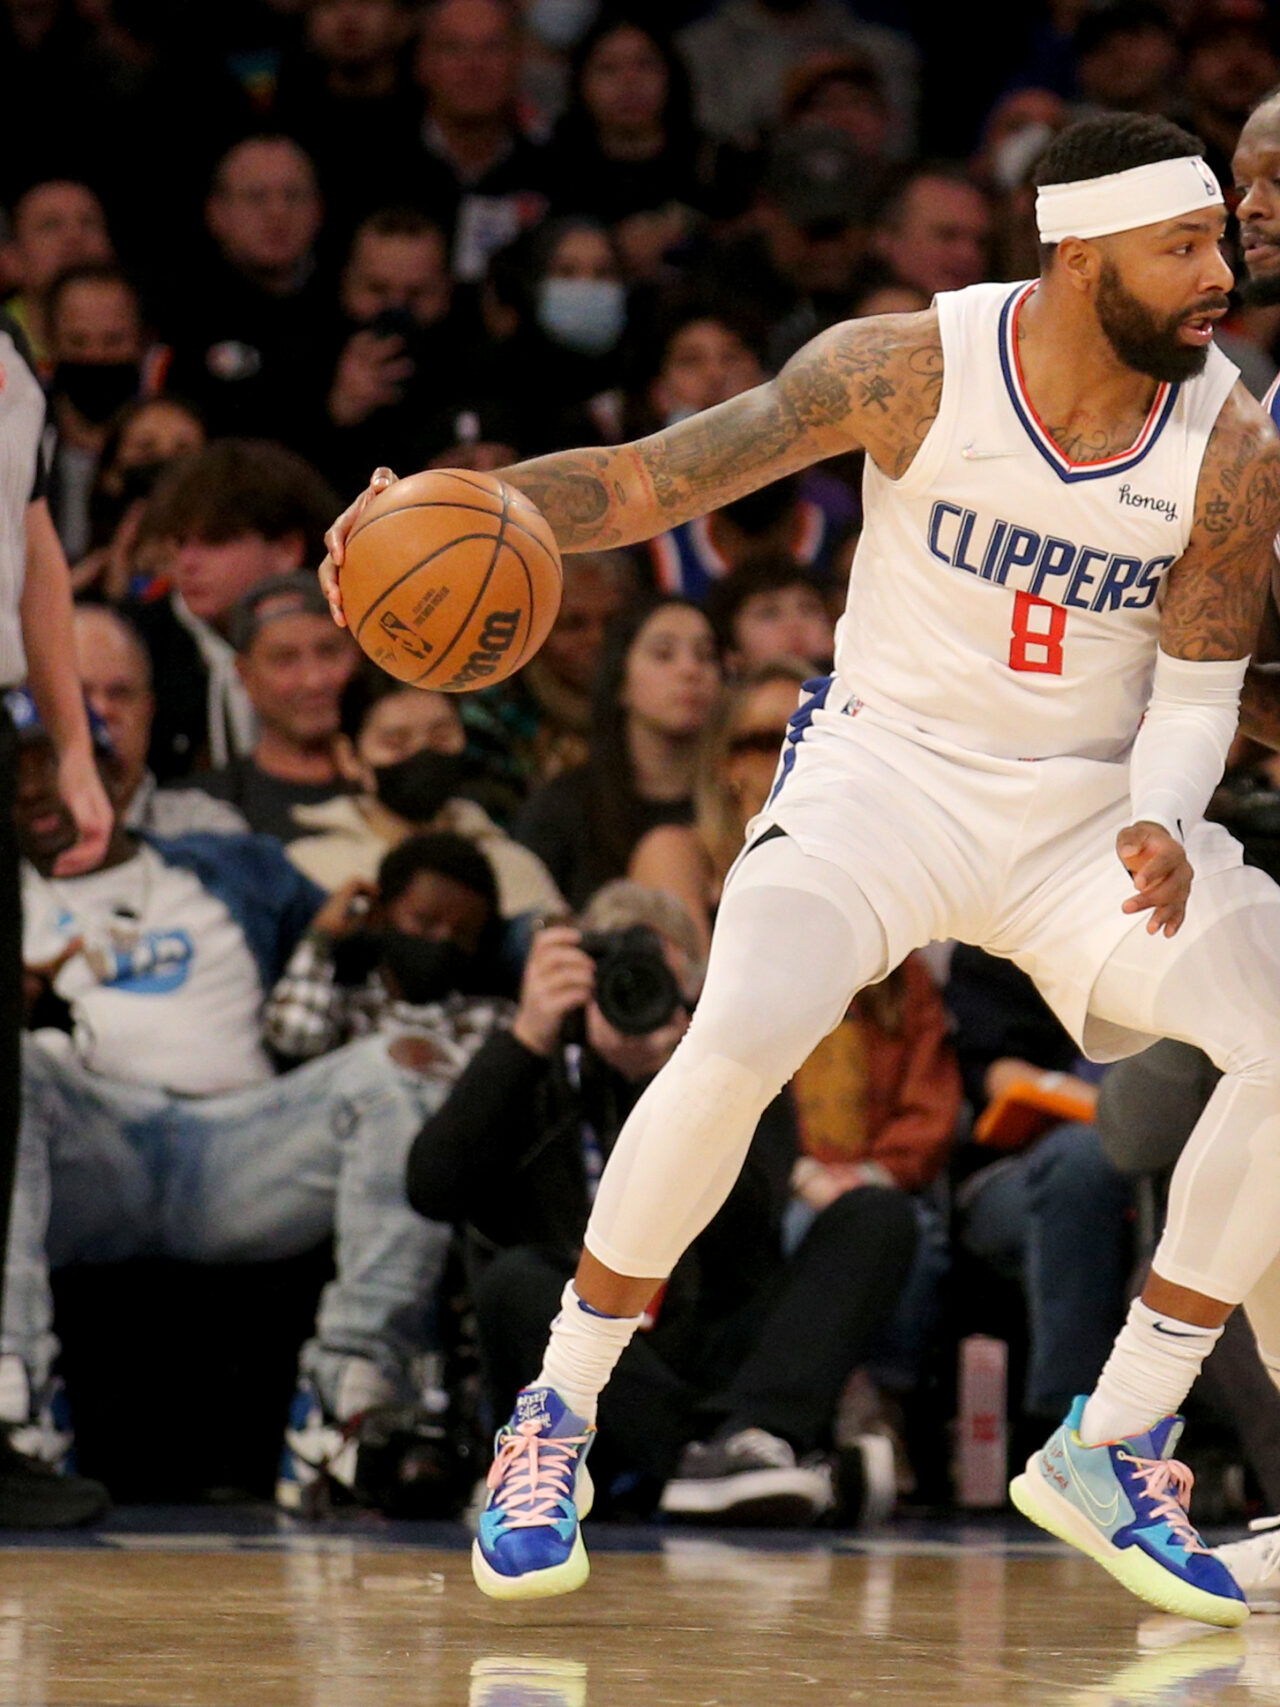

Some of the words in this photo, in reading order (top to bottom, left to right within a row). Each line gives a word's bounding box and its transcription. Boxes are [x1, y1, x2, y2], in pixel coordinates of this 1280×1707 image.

[1118, 484, 1178, 522] honey
[927, 499, 1177, 613] CLIPPERS
[1009, 590, 1068, 676] 8
